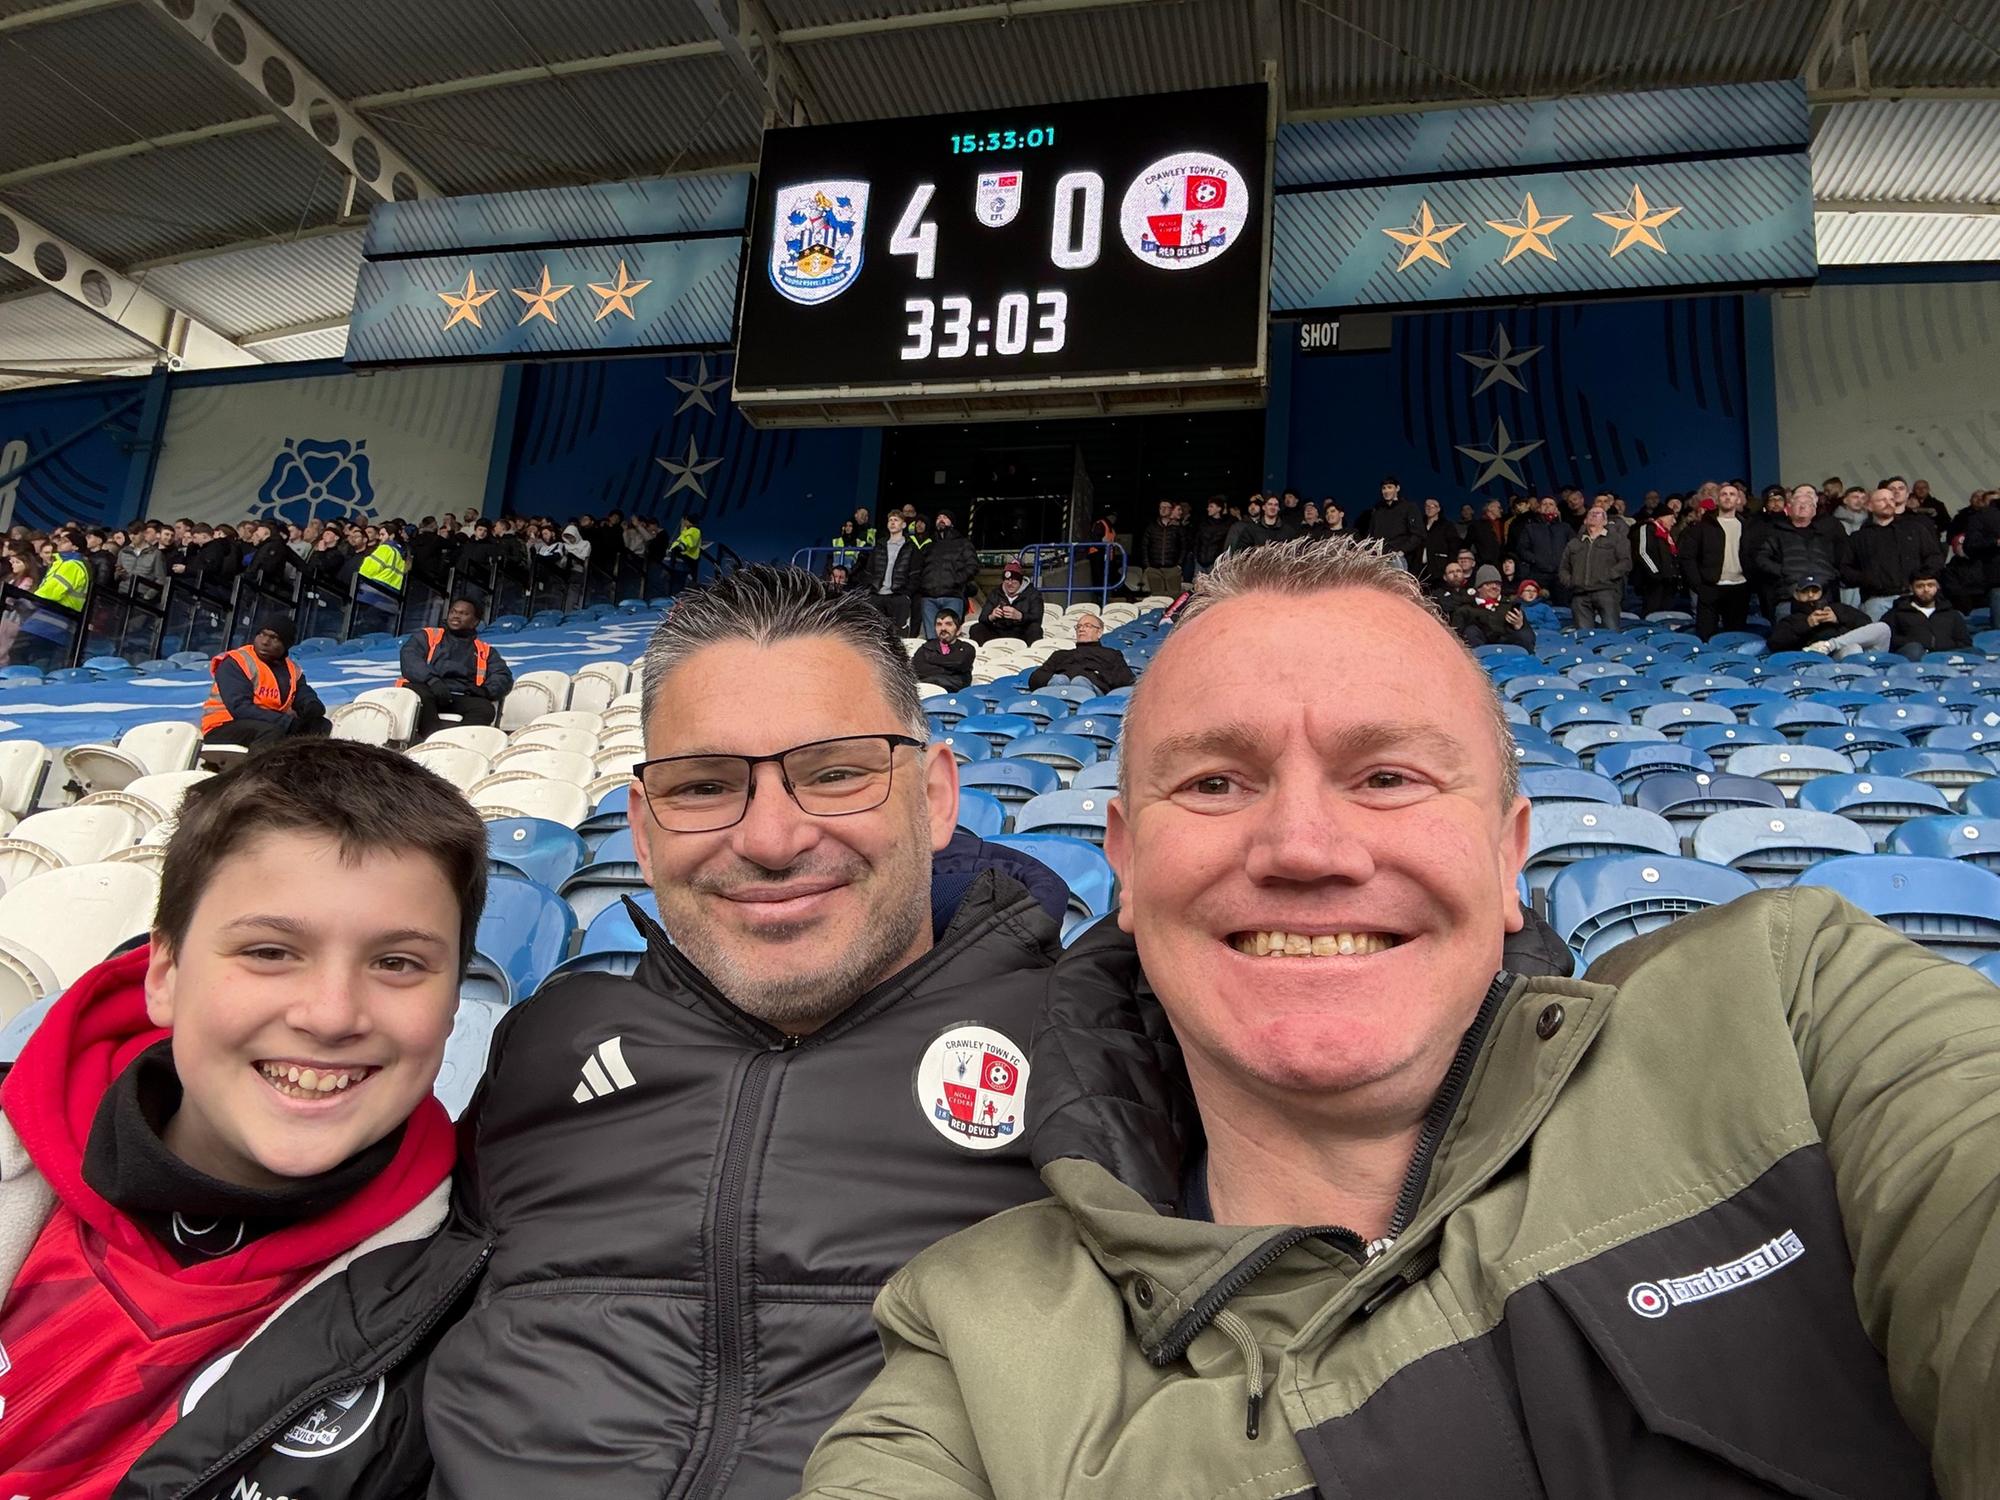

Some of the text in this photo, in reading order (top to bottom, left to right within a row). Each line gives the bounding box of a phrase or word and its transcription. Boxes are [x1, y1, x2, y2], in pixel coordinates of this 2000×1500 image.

[951, 127, 1055, 154] 15:33:01
[1145, 165, 1229, 185] CRAWLEY TOWN FC
[889, 184, 938, 279] 4
[1051, 172, 1105, 269] 0
[1158, 244, 1207, 257] RED DEVILS
[901, 291, 1067, 360] 33:03
[1300, 322, 1340, 348] SHOT
[945, 1039, 983, 1050] CRAWLEY
[986, 1043, 1010, 1060] TOWN
[1009, 1055, 1021, 1066] FC
[951, 1120, 996, 1137] RED DEVILS
